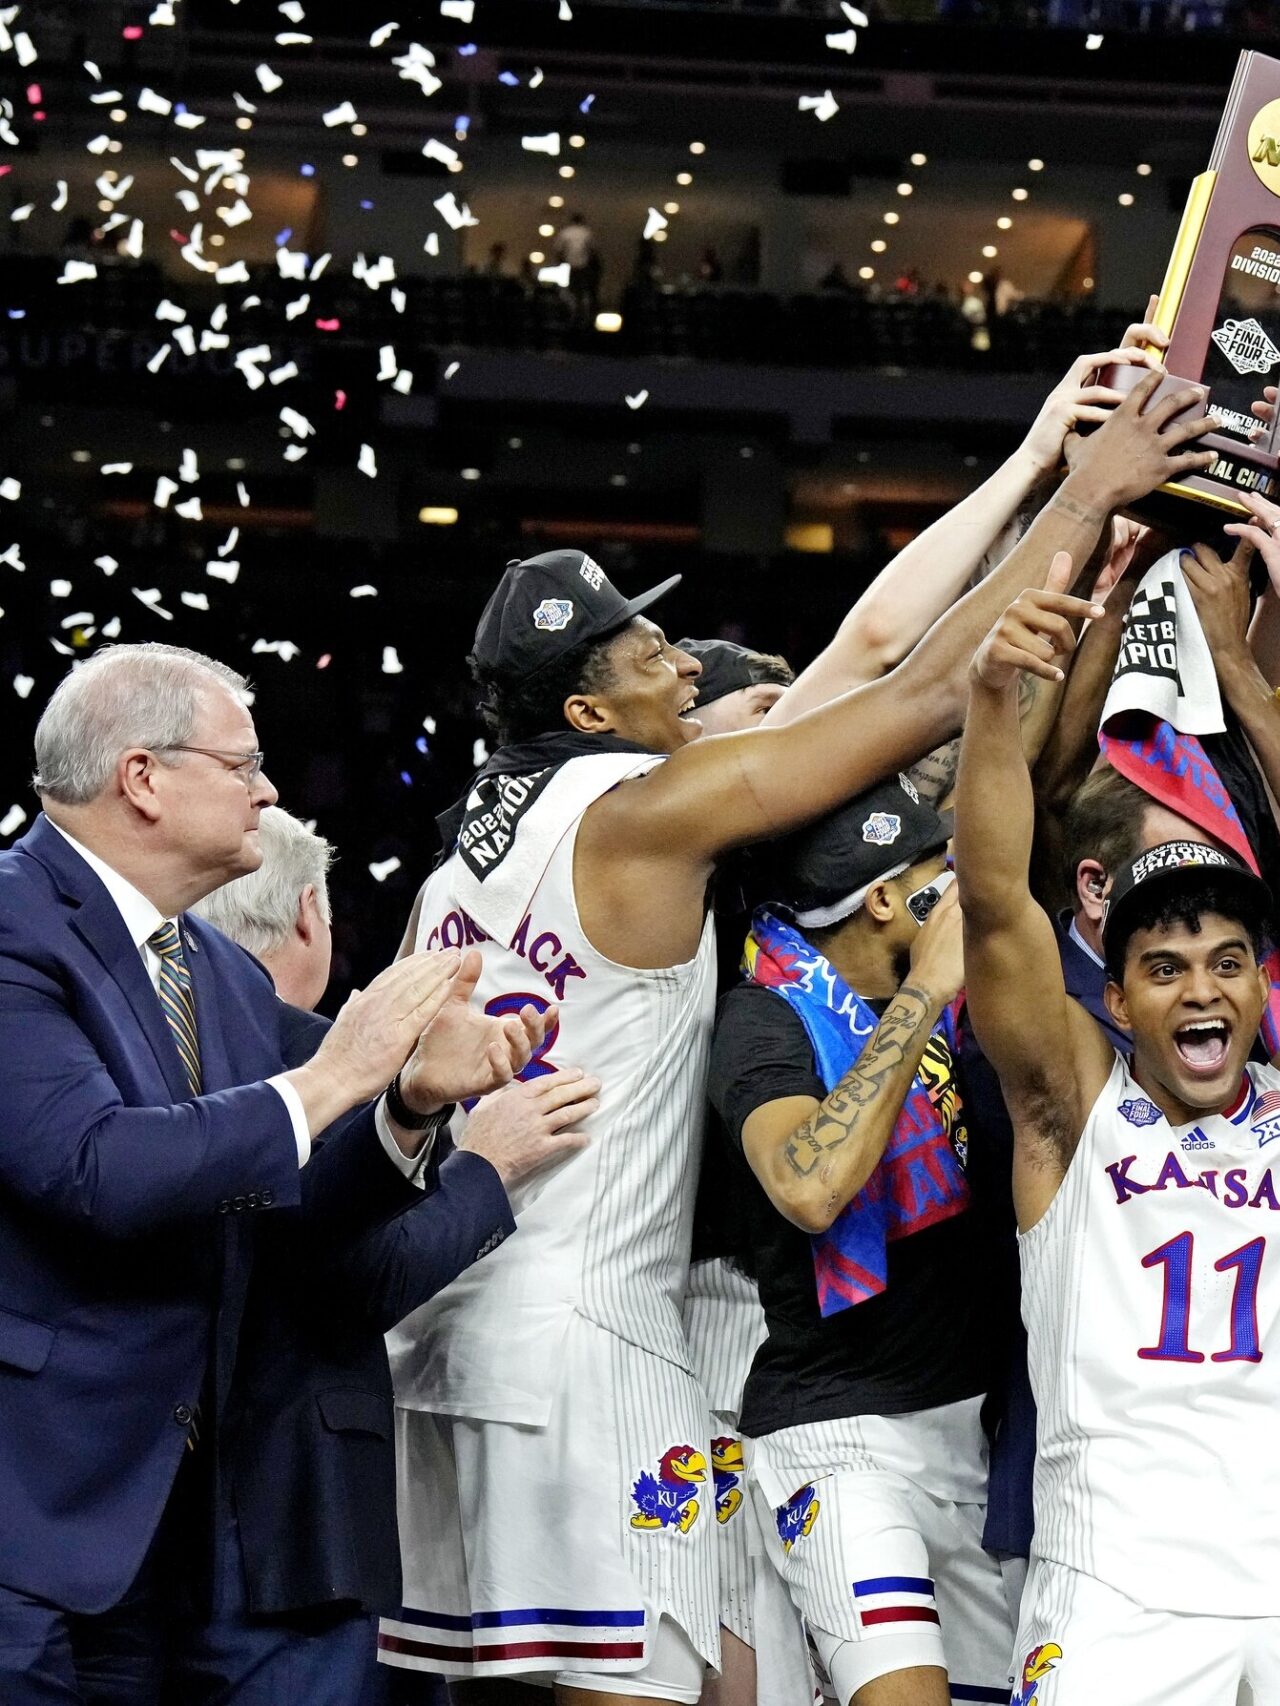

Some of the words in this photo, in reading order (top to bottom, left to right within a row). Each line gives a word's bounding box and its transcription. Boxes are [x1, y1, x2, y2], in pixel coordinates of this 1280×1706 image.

[1233, 328, 1266, 350] FINAL
[1228, 340, 1263, 361] FOUR
[426, 909, 587, 1001] CORACK
[1137, 1230, 1266, 1364] 11
[657, 1490, 677, 1508] KU
[786, 1505, 803, 1527] KU
